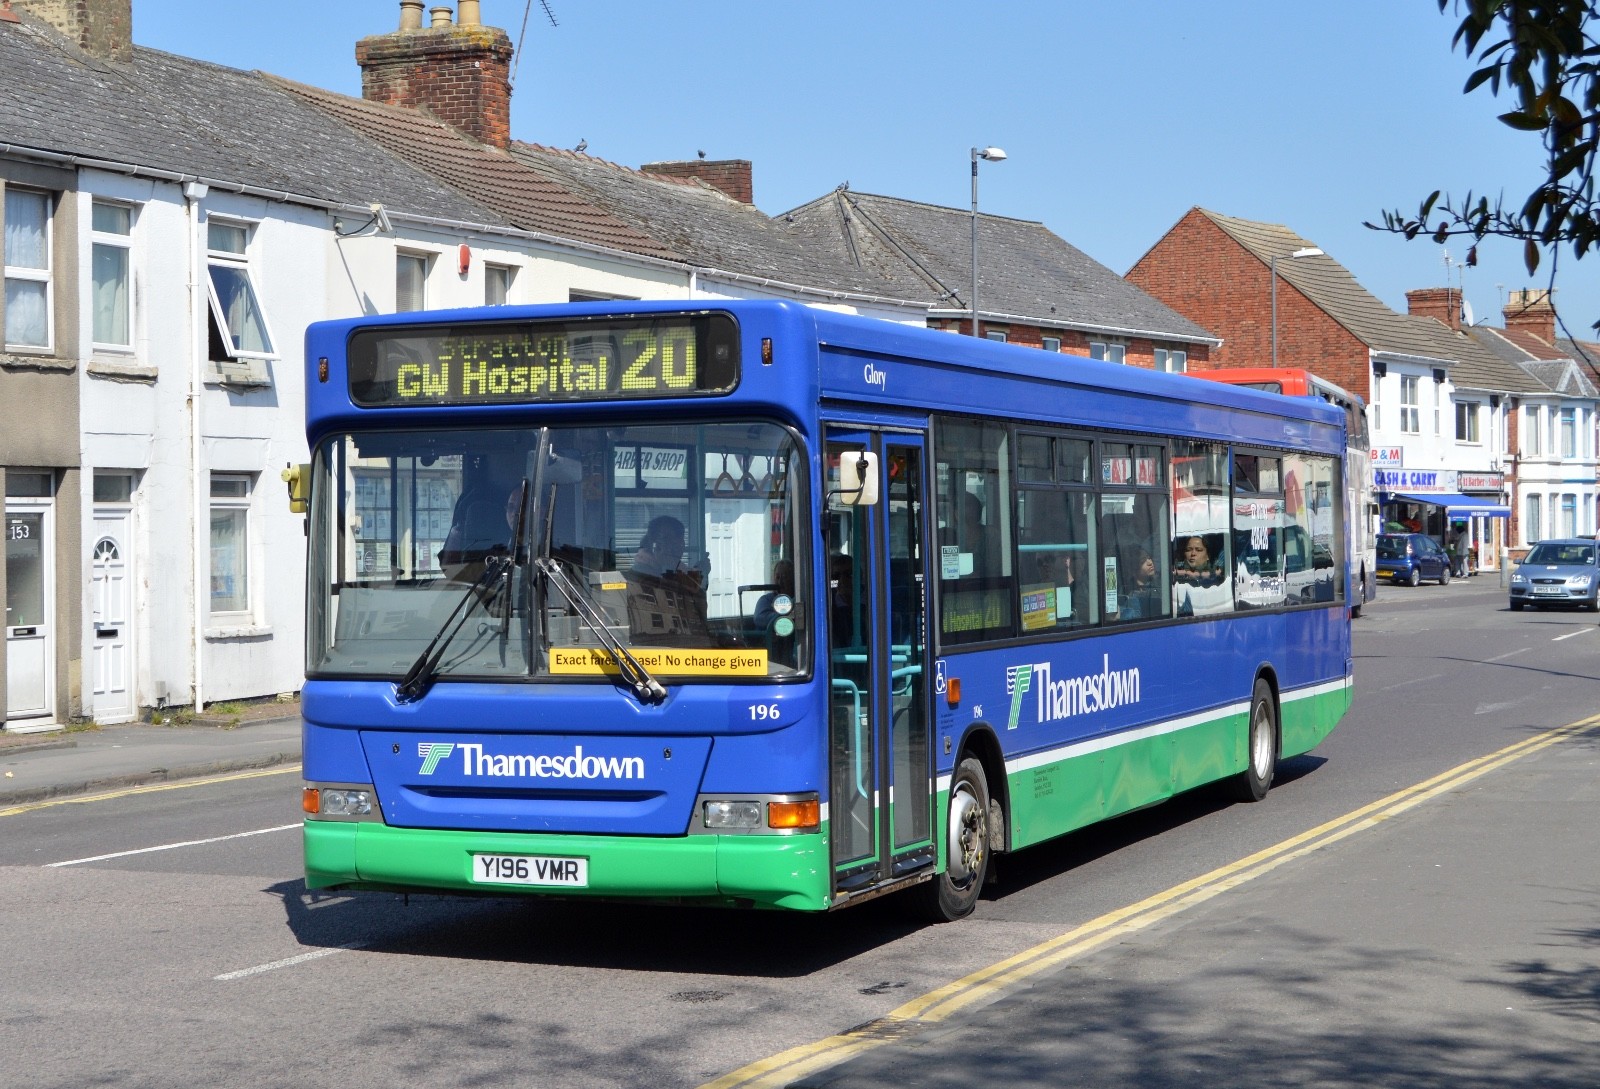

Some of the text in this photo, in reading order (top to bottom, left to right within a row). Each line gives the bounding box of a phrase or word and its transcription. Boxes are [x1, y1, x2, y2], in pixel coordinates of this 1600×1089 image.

[621, 326, 697, 390] 20
[397, 355, 607, 398] GW Hospital
[863, 362, 887, 392] Glory
[652, 452, 685, 471] SHOP
[1371, 449, 1400, 460] B & M
[1374, 471, 1438, 486] CASH & CARRY
[10, 525, 30, 540] 153
[556, 653, 587, 666] Exact
[621, 654, 662, 668] ase!
[665, 654, 681, 666] No
[684, 655, 726, 670] change
[730, 655, 762, 670] given
[1033, 653, 1140, 724] Thamesdown
[749, 703, 781, 721] 196
[456, 743, 646, 780] Thamesdown
[481, 857, 579, 882] Y196 VMR
